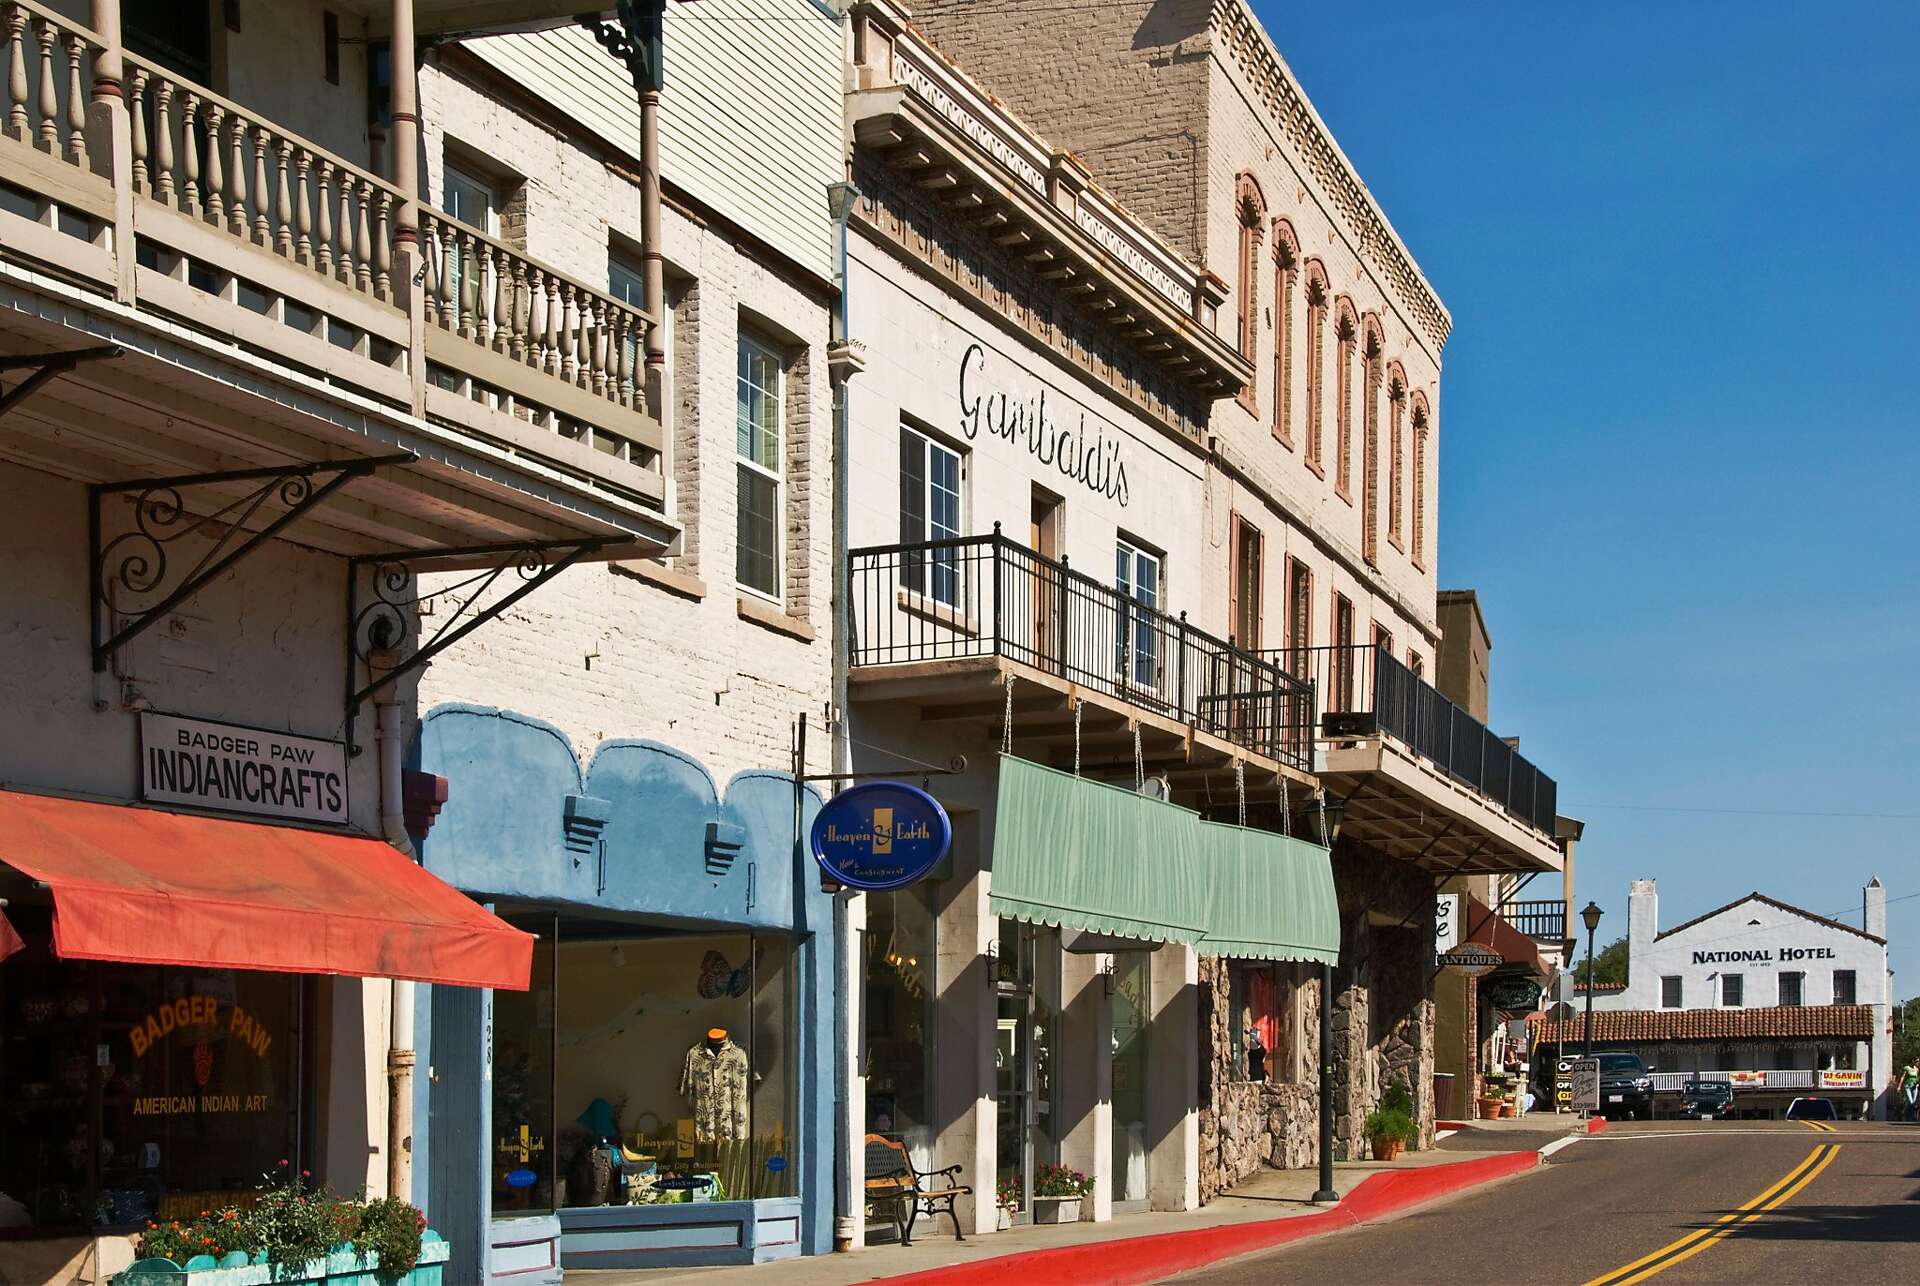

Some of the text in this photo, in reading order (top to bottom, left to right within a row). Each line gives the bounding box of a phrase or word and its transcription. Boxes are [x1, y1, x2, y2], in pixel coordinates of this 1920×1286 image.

[959, 343, 1129, 508] Garibaldi's
[178, 729, 315, 765] BADGER PAW
[150, 747, 342, 813] INDIANCRAFTS
[827, 824, 871, 846] Heaven
[896, 821, 930, 840] Earth
[1443, 955, 1504, 965] ANTIQUES
[129, 993, 271, 1057] BADGER PAW
[133, 1095, 267, 1115] AMERICAN INDIAN ART
[636, 1133, 675, 1150] Heaven
